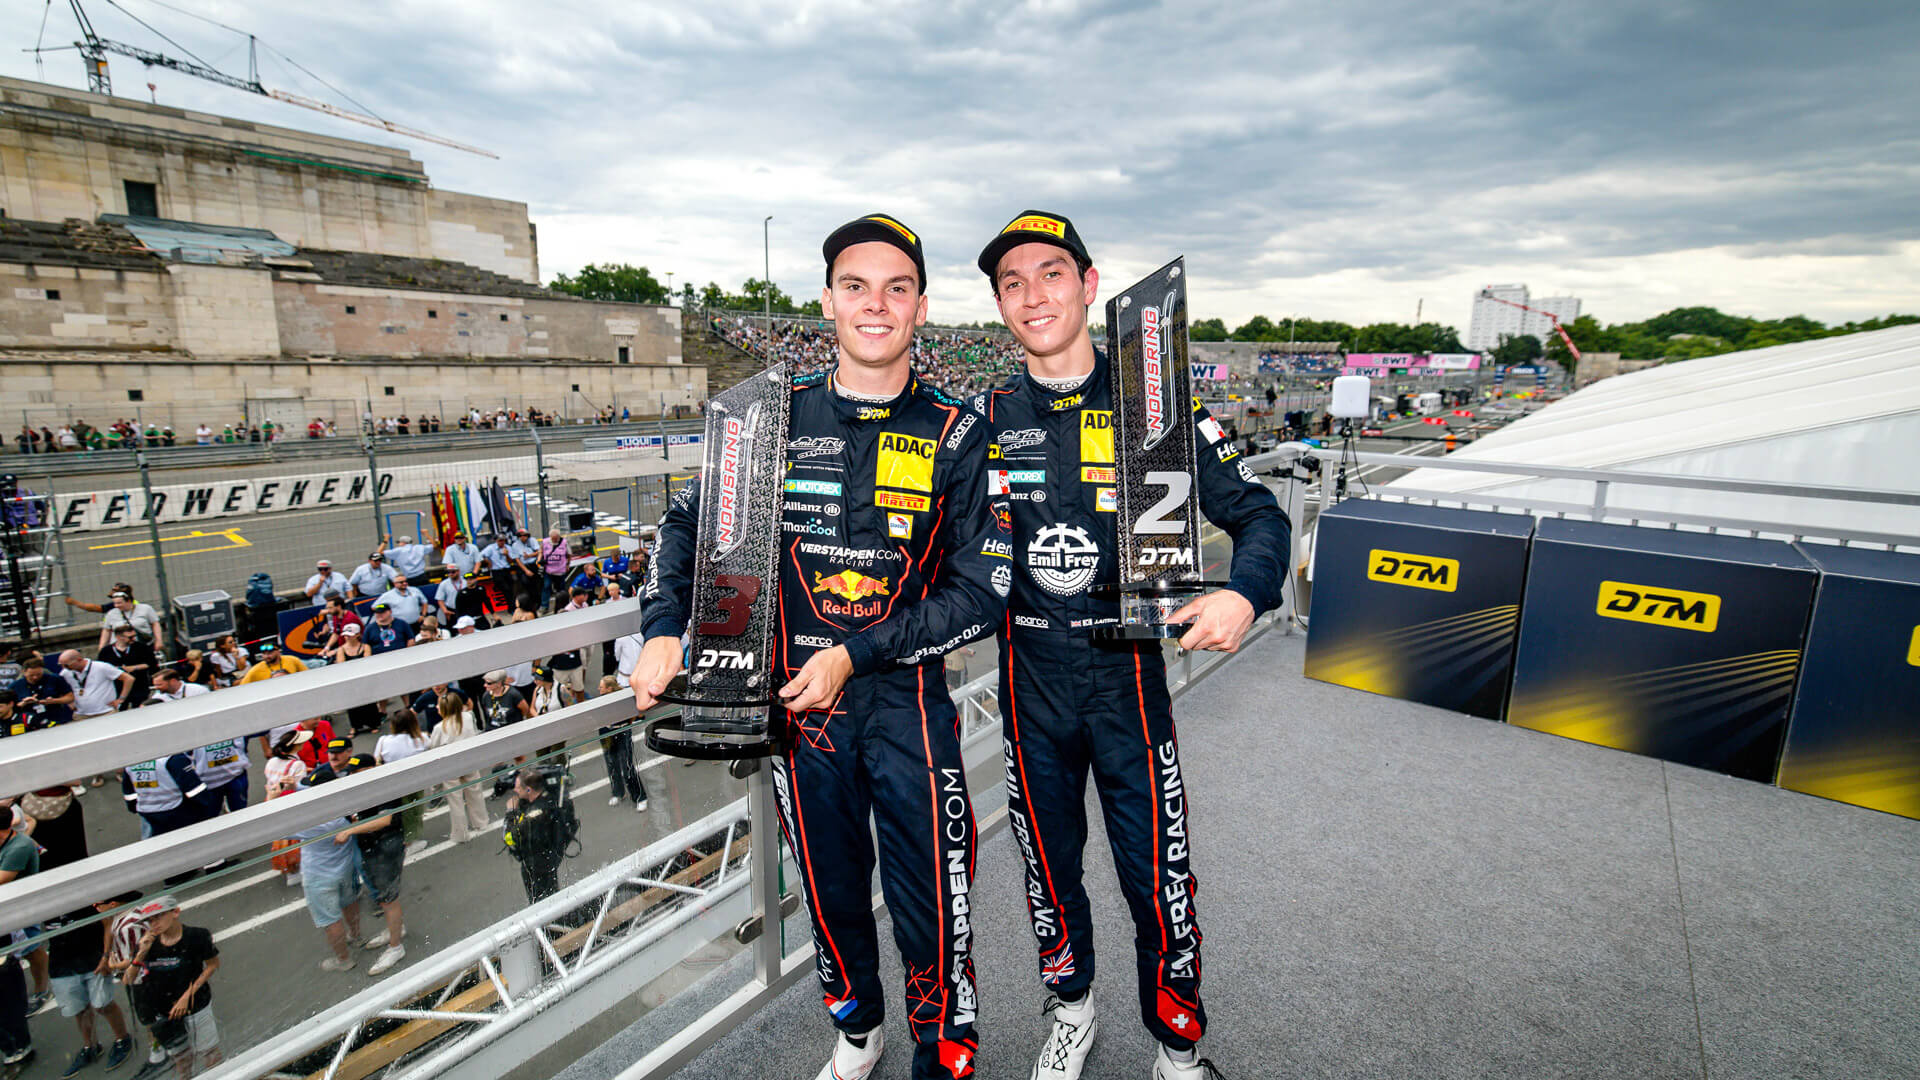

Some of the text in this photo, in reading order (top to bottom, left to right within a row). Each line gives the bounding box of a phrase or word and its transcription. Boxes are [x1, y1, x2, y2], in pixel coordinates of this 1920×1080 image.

[1145, 309, 1162, 430] NORISRING
[859, 407, 891, 420] DTM
[946, 413, 978, 451] sparco
[790, 436, 846, 452] Emil Frey
[881, 434, 934, 459] ADAC
[718, 420, 741, 543] NORISRING
[796, 480, 840, 495] MOTOREX
[783, 501, 822, 513] Allianz
[880, 493, 925, 509] PIRELLI
[1133, 471, 1192, 535] 2
[783, 517, 837, 537] MaxiCool
[800, 542, 902, 562] VERSTAPPEN.COM
[829, 556, 873, 567] RACING
[1028, 553, 1100, 569] Emil Frey
[1138, 547, 1193, 566] DTM
[1374, 556, 1451, 587] DTM
[698, 574, 762, 636] 3
[822, 599, 881, 618] Red Bull
[1606, 588, 1709, 625] DTM
[1015, 615, 1049, 629] sparco
[794, 634, 833, 648] sparco
[697, 650, 755, 670] DTM
[213, 748, 232, 760] 252
[1159, 740, 1189, 866] RACING
[941, 768, 977, 1026] VERSTAPPEN.COM
[1167, 868, 1192, 940] FREY
